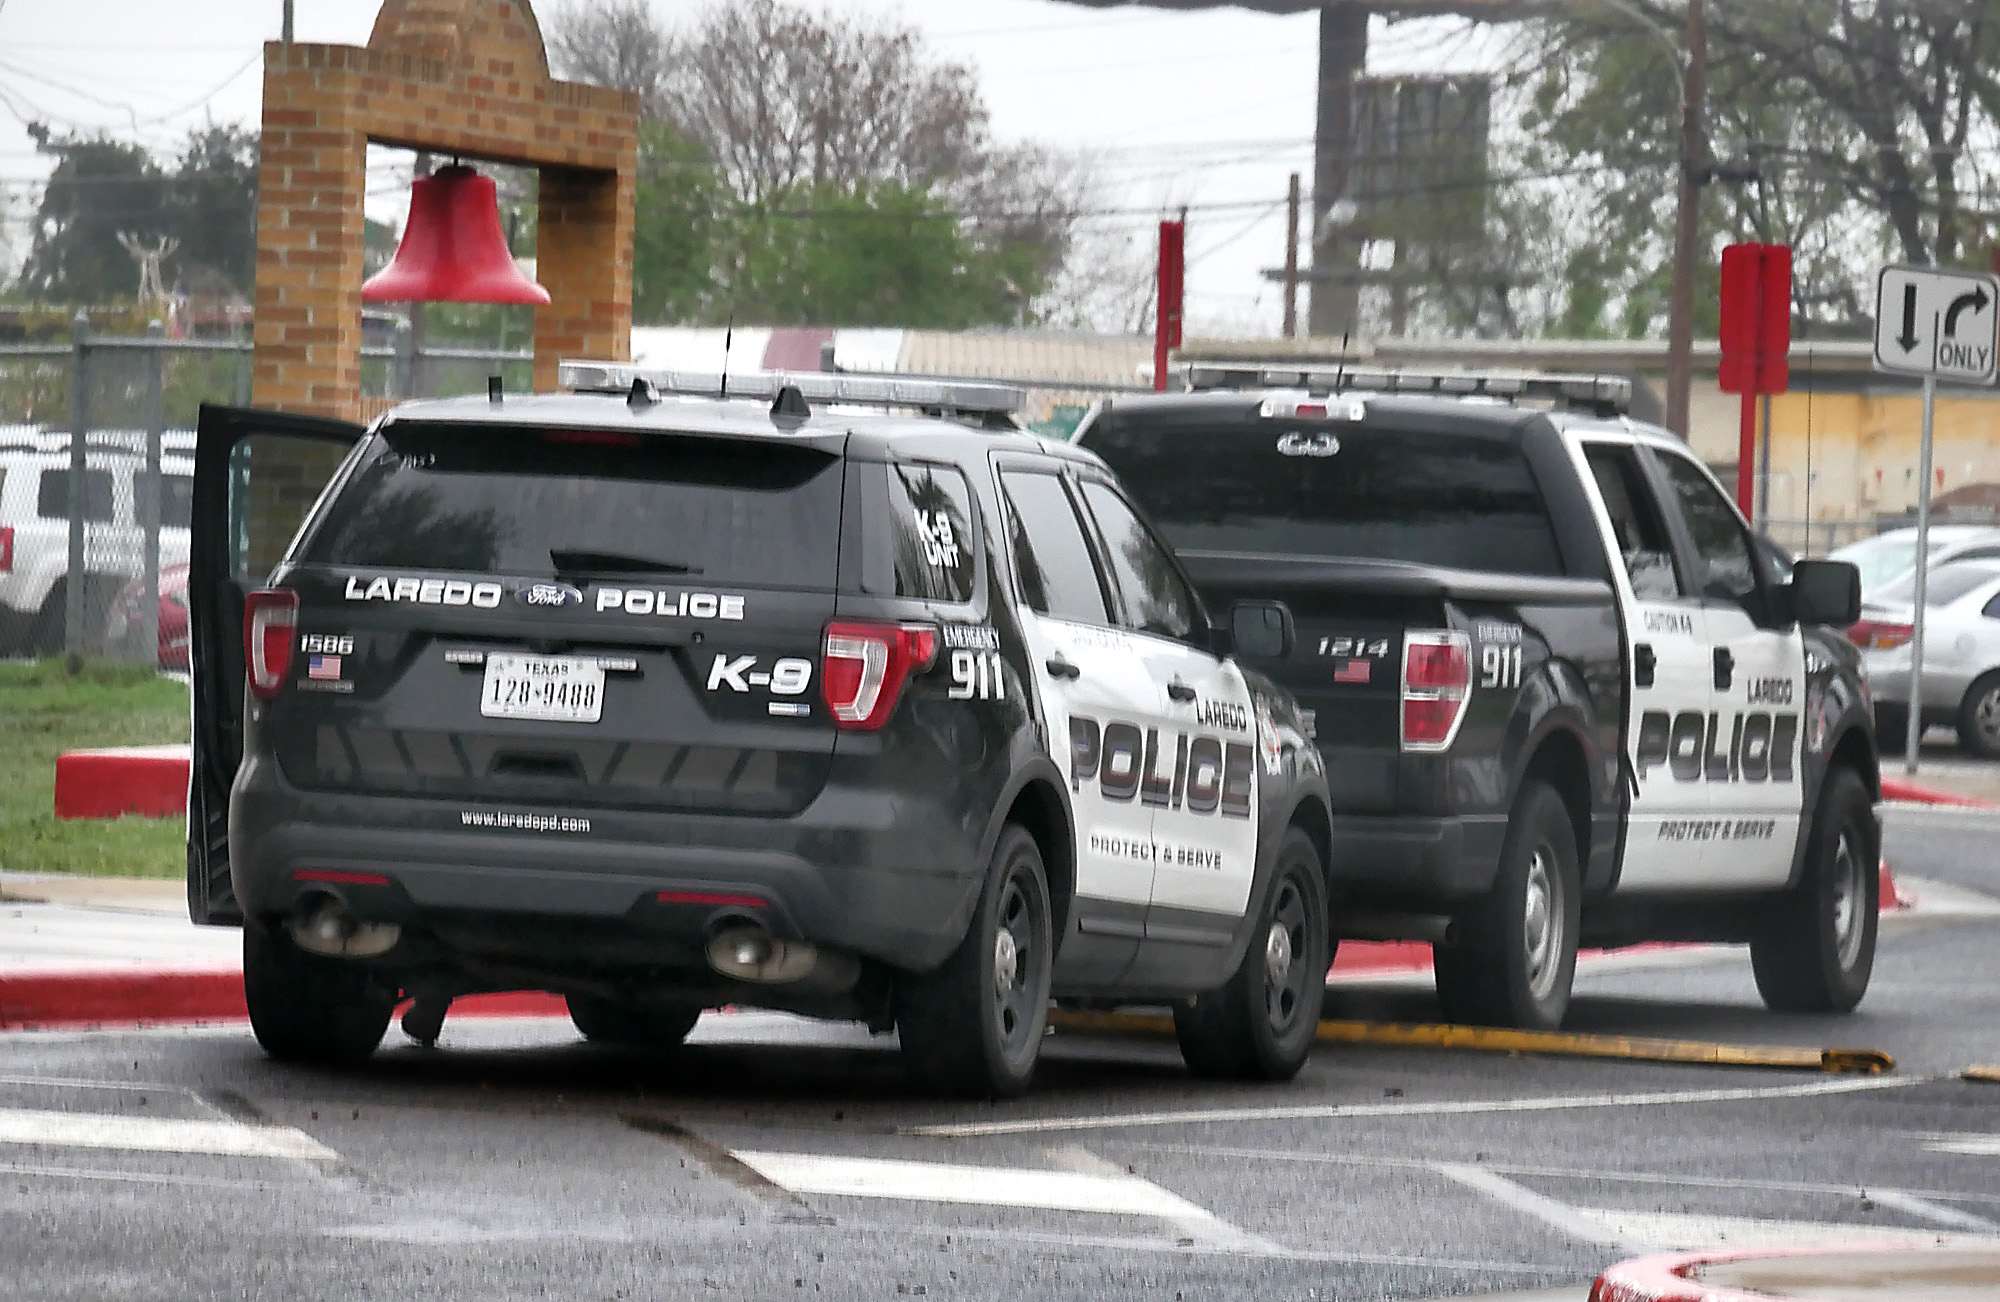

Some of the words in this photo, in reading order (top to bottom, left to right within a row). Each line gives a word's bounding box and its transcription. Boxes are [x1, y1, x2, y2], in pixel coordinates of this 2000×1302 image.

[1940, 342, 1989, 370] ONLY
[913, 508, 953, 545] K-9
[923, 540, 959, 568] UNIT
[345, 575, 501, 608] LAREDO
[596, 588, 745, 620] POLICE
[300, 633, 354, 655] 1586
[1318, 636, 1389, 658] 1214
[524, 662, 569, 676] TEXAS
[706, 653, 813, 695] K-9
[948, 649, 1004, 700] 911
[1481, 644, 1522, 688] 911
[1748, 677, 1793, 704] LAREDO
[1194, 696, 1247, 732] LAREDO
[1635, 710, 1798, 782] POLICE
[1068, 713, 1254, 820] POLICE
[461, 811, 590, 832] www.laredopd.com
[1657, 819, 1721, 841] PROTECT
[1733, 820, 1776, 840] SERVE
[1090, 833, 1157, 860] PROTECT
[1163, 846, 1173, 863] &
[1176, 847, 1221, 870] SERVE
